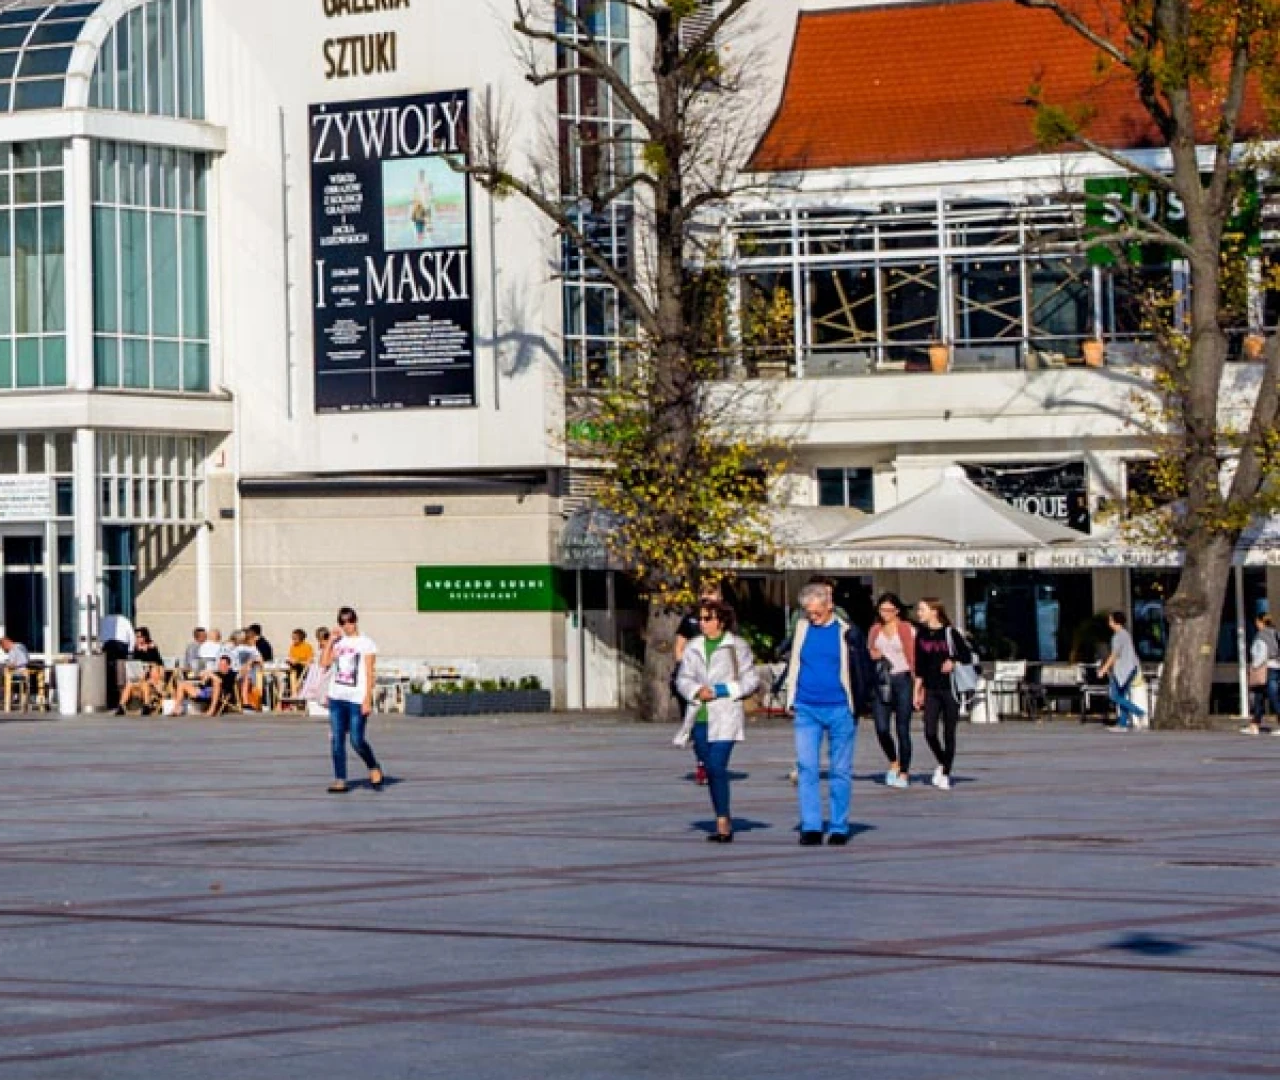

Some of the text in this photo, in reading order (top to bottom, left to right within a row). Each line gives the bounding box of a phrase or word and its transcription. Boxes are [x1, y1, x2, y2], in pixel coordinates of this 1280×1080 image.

[322, 31, 397, 80] SZTUKI
[312, 100, 464, 163] ŻYWIOŁY
[315, 249, 470, 308] I MASKI
[1005, 492, 1068, 518] IQUE
[425, 579, 544, 589] AVOCADO SUSHI
